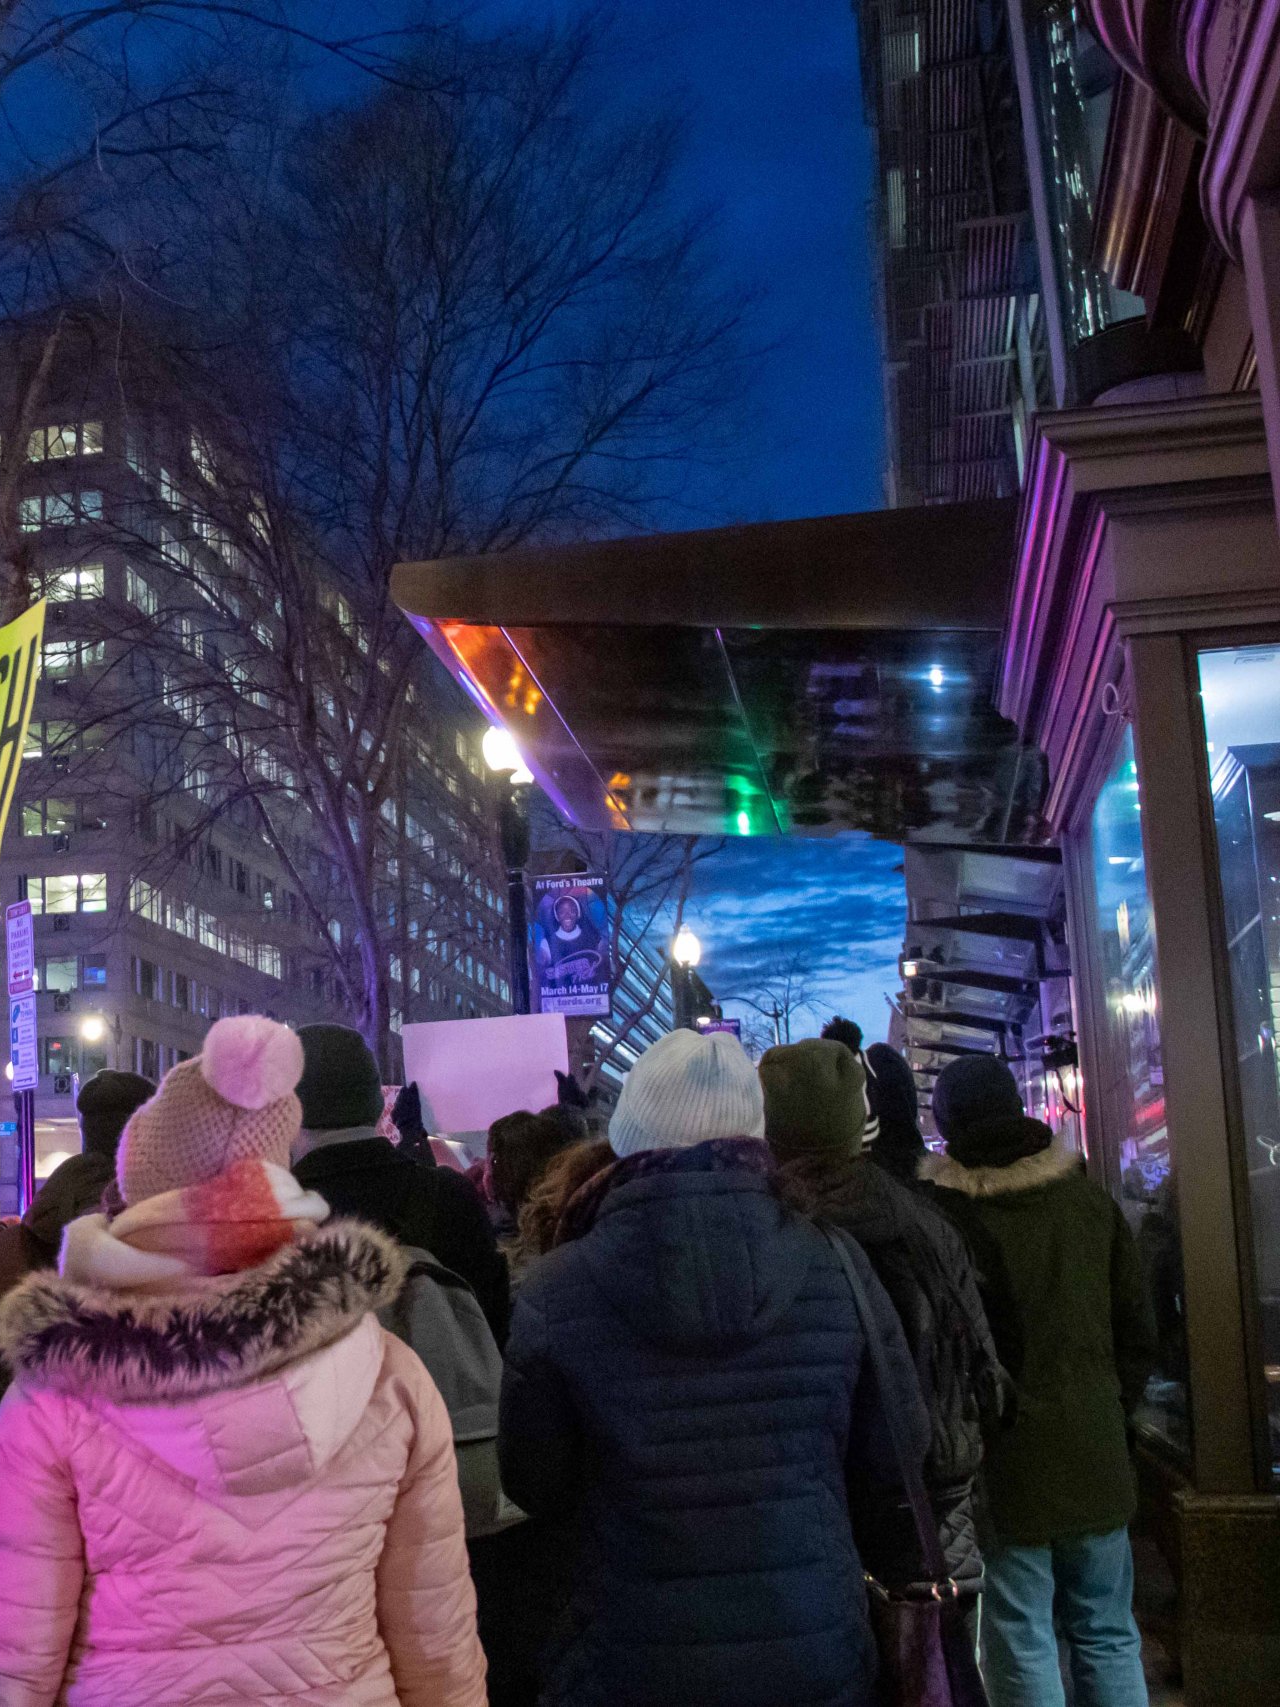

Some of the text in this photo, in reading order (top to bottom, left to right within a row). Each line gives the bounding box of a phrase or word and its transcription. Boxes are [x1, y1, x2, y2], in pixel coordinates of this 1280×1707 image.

[535, 877, 604, 890] At Ford's Theatre
[541, 982, 609, 996] March 14-May 17
